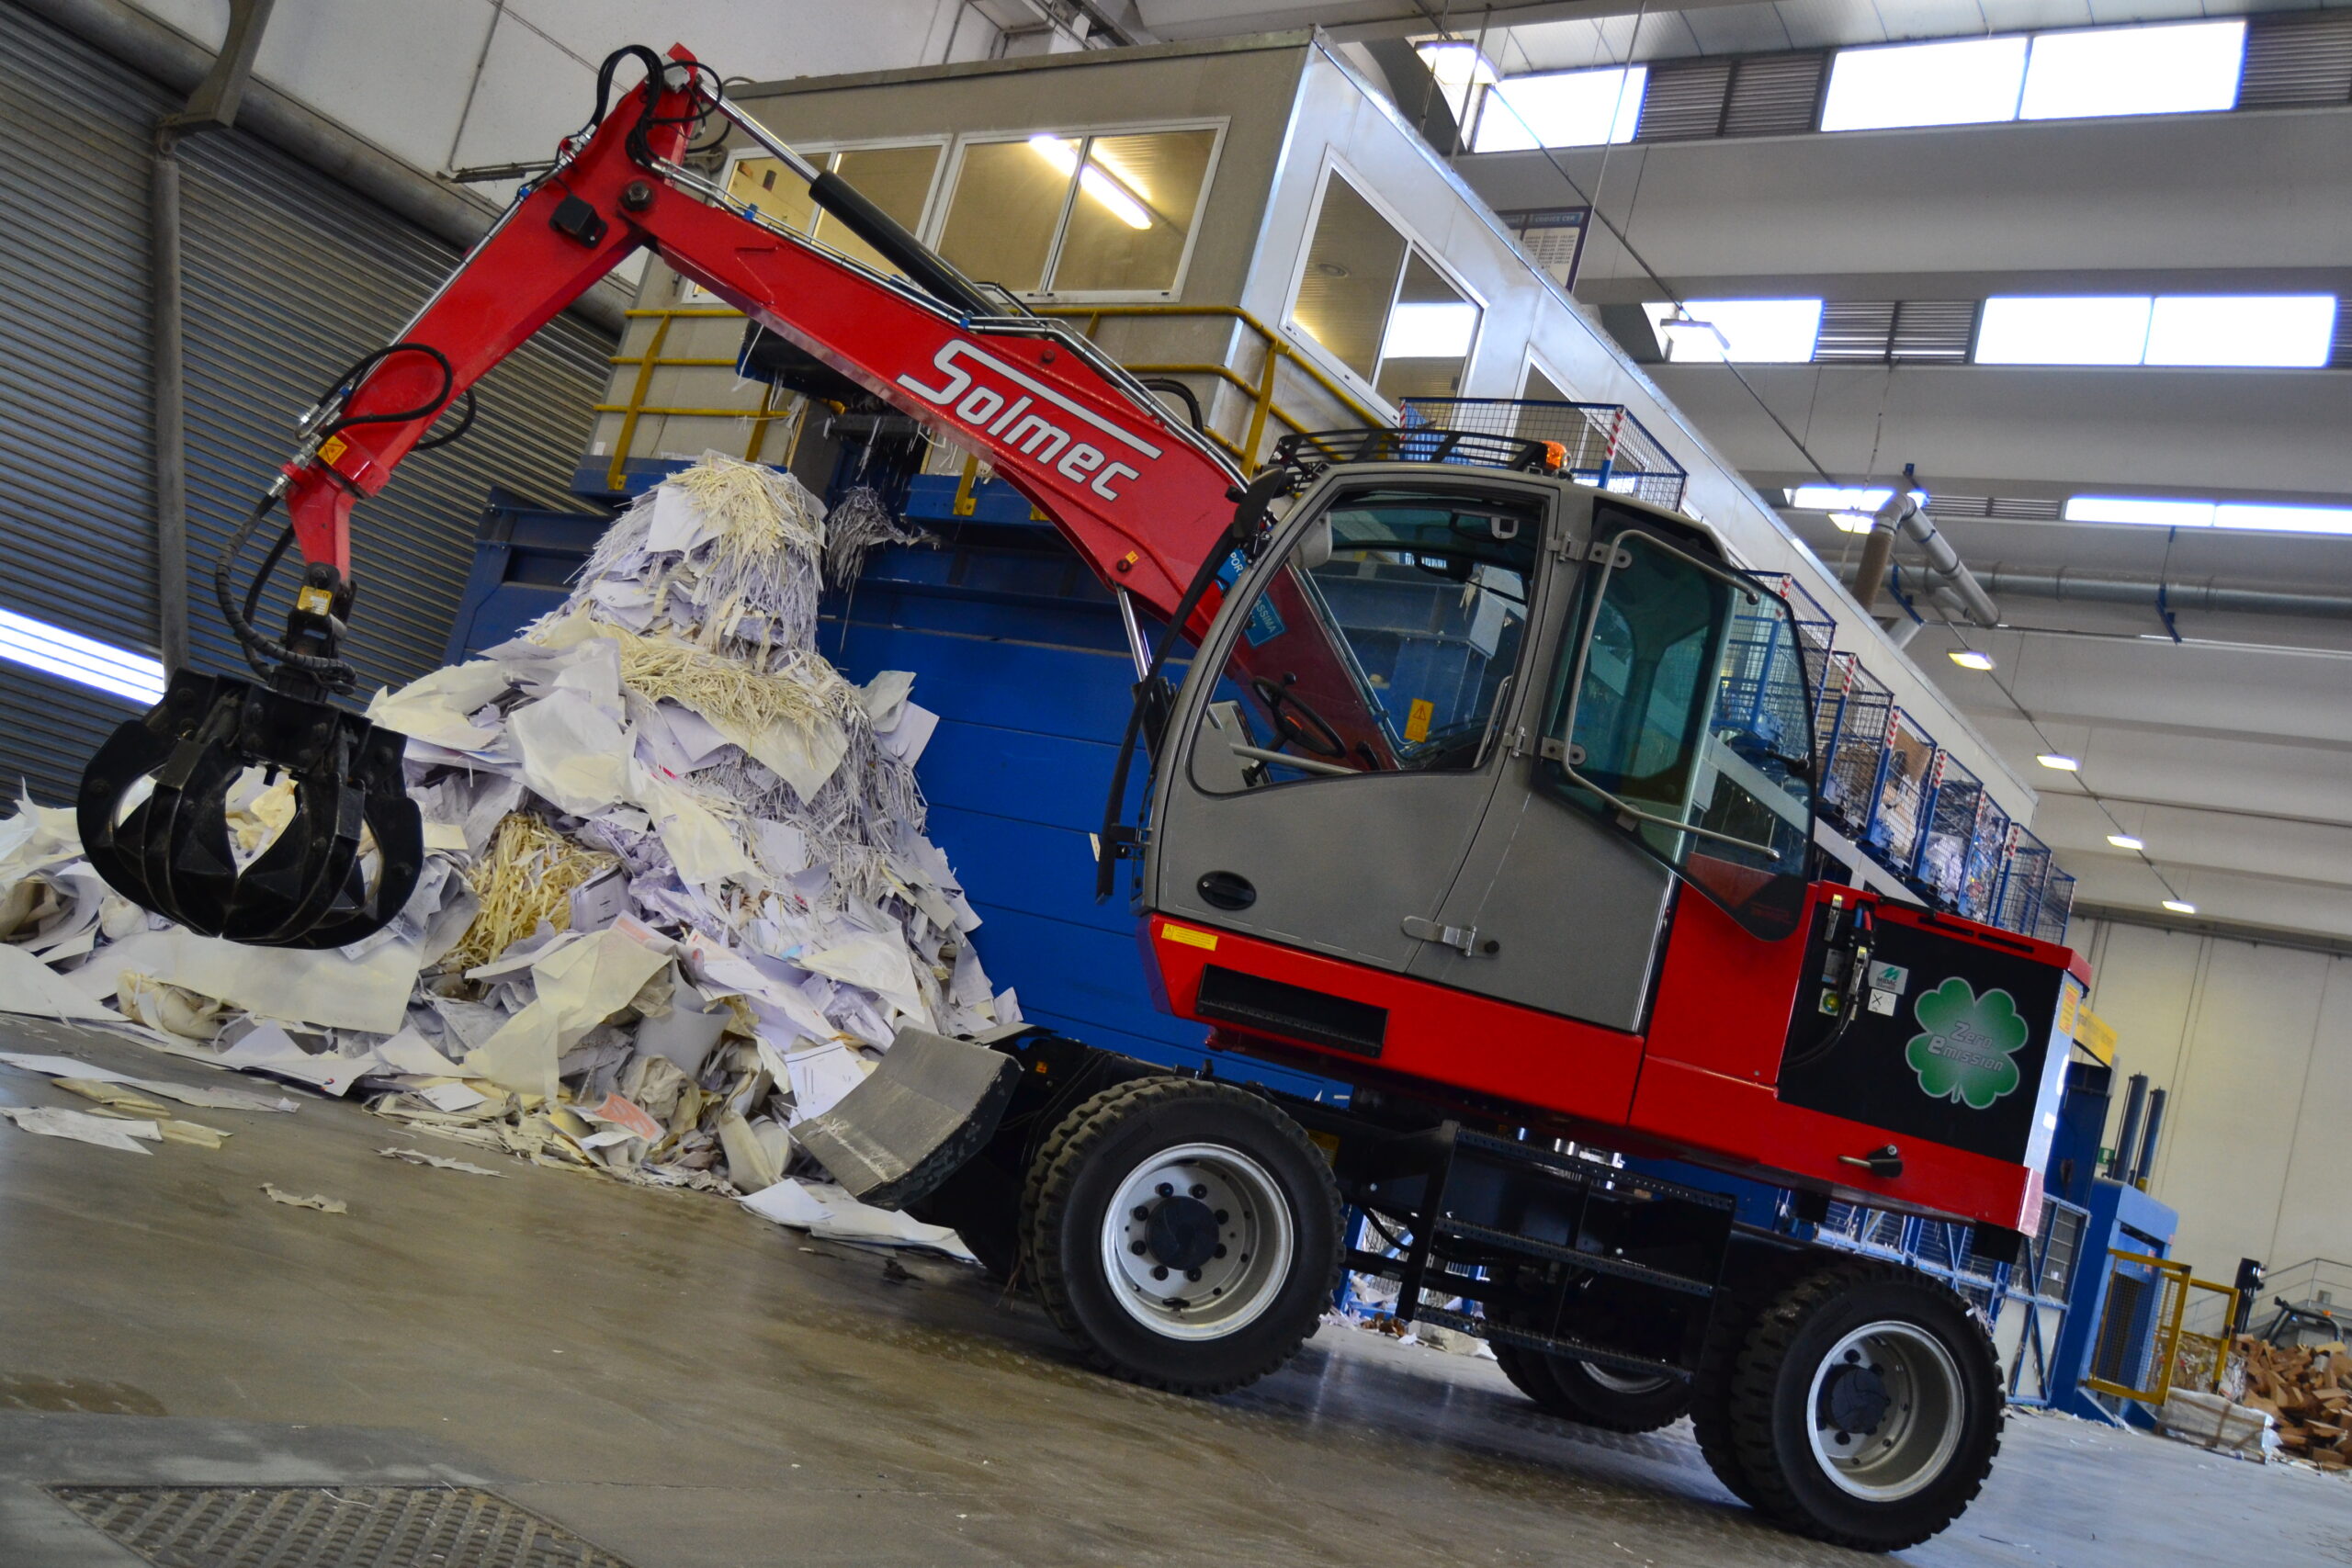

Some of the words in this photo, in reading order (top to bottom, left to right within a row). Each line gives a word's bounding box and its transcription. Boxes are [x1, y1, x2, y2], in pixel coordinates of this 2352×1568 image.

[896, 338, 1163, 502] Solmec
[1229, 551, 1245, 576] POR
[1256, 599, 1277, 633] ASSIMA
[1950, 1021, 1993, 1049] Zero
